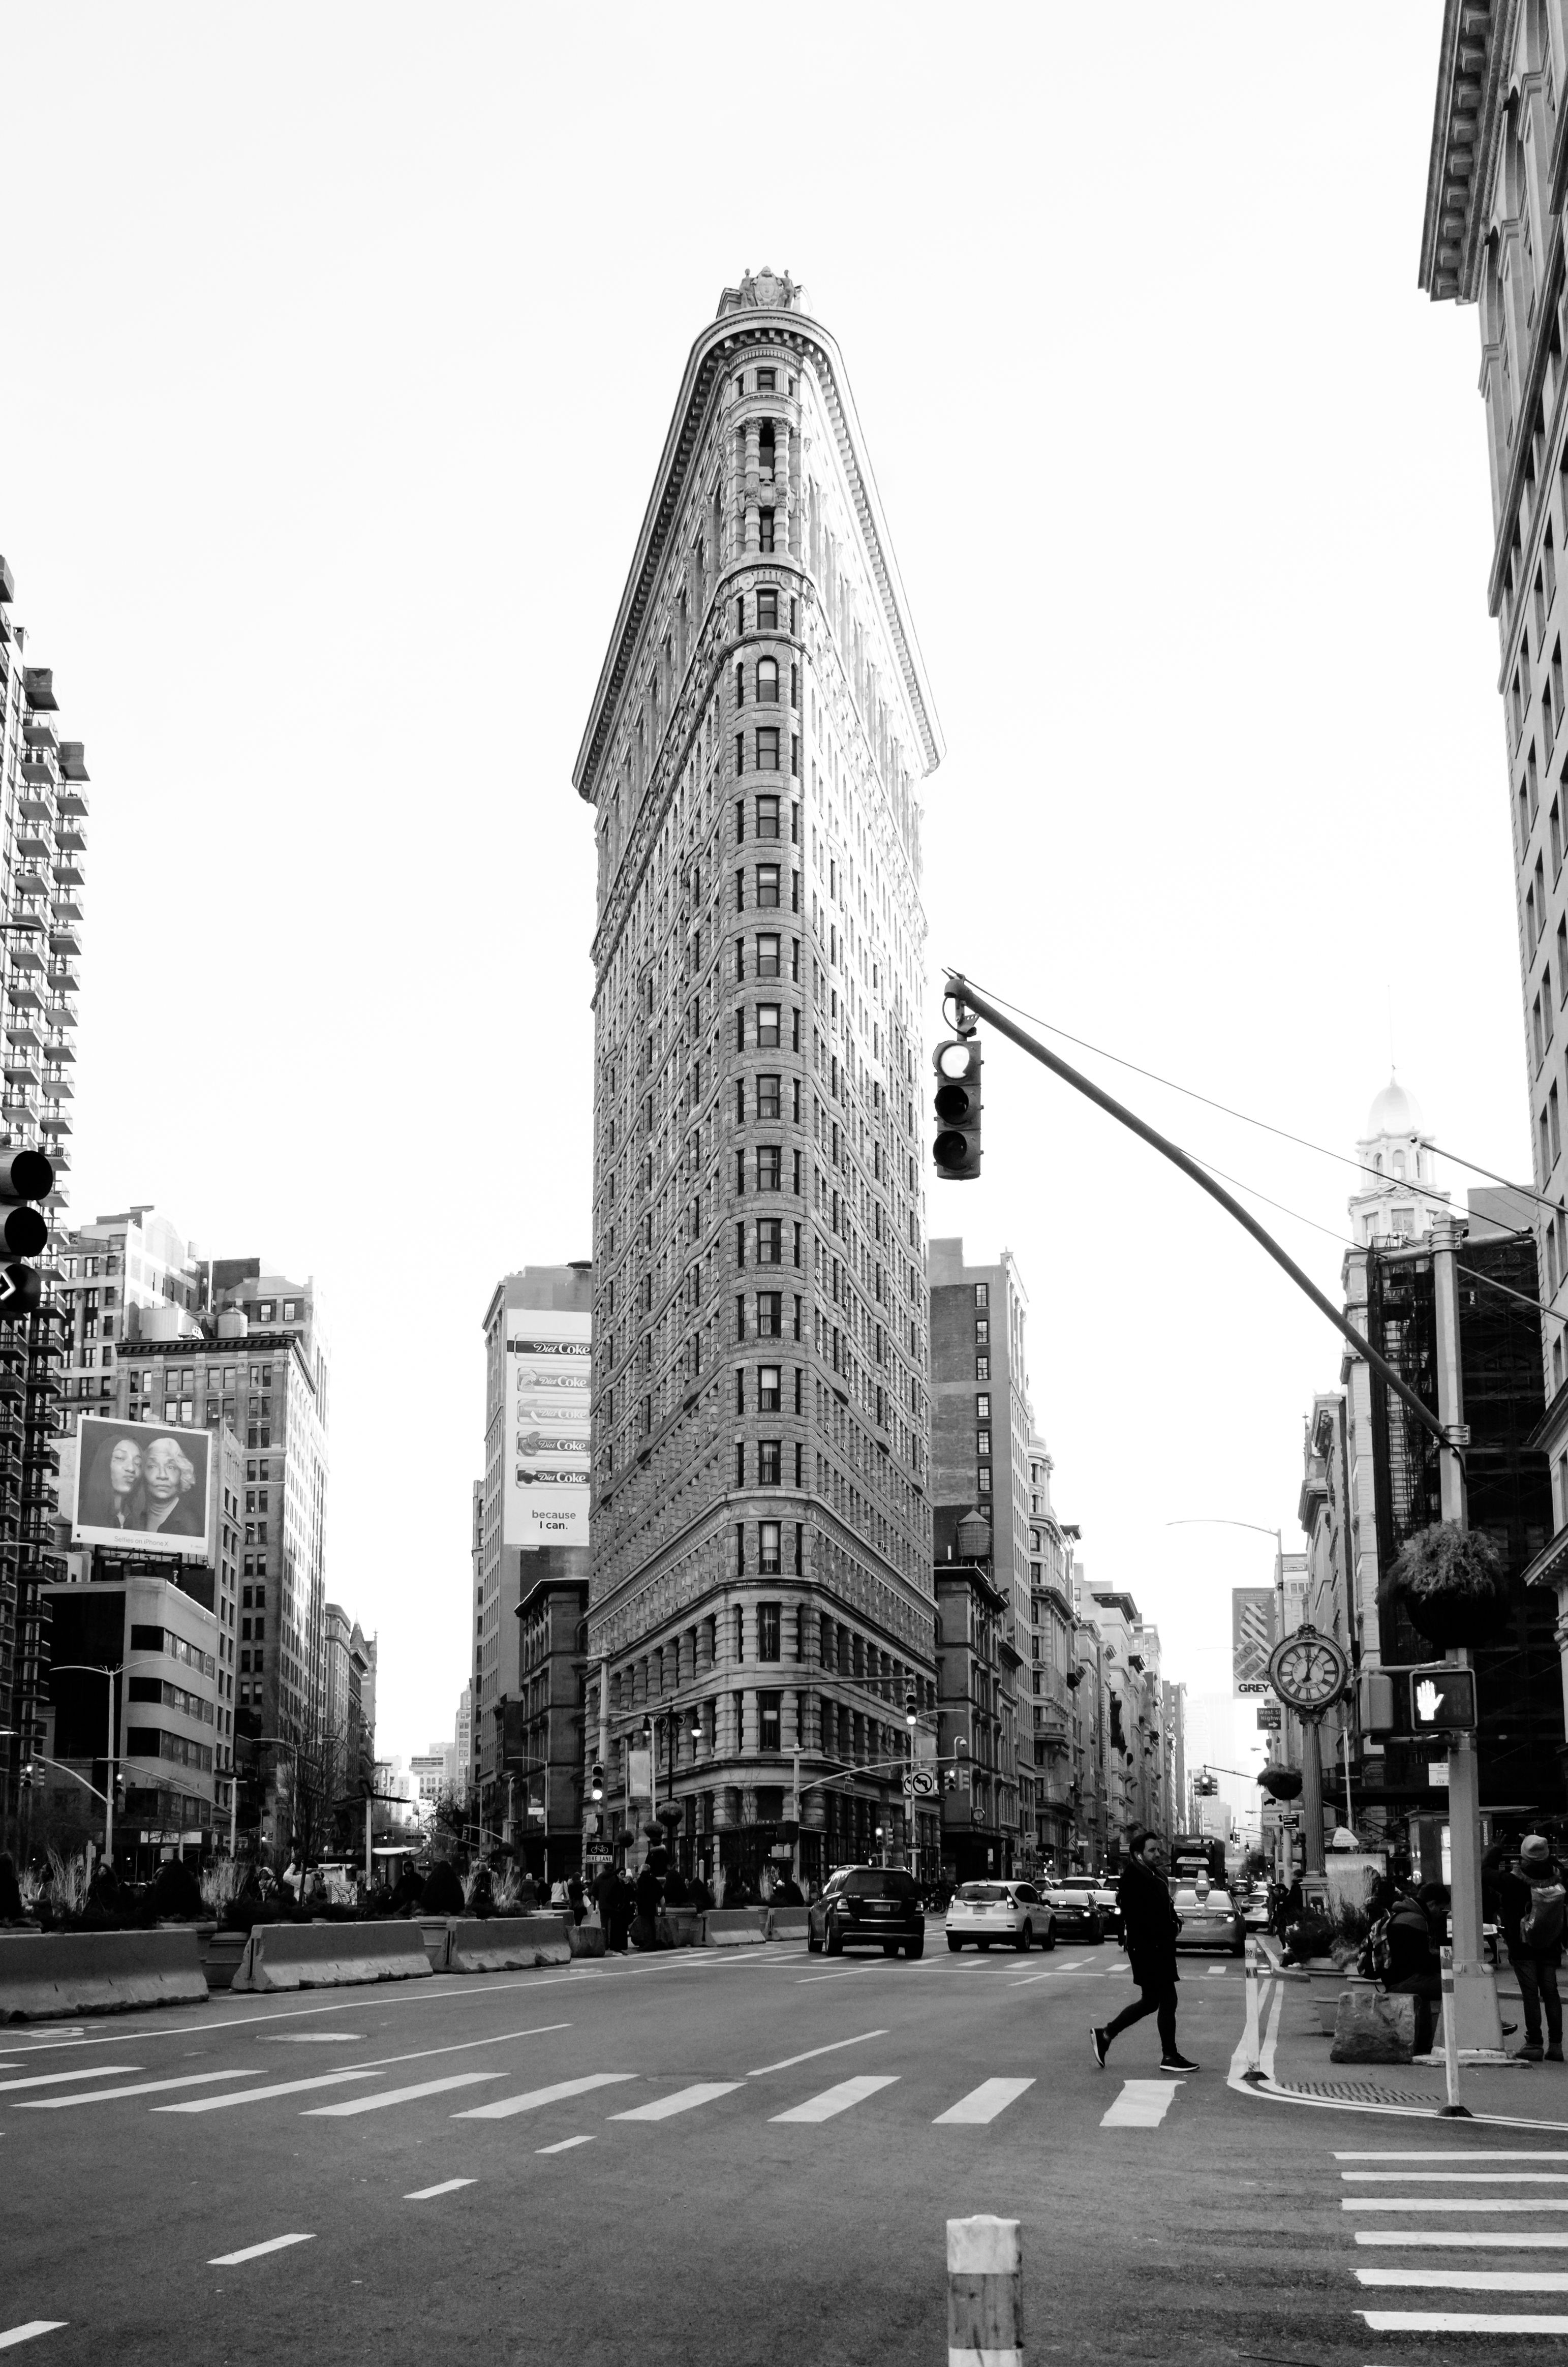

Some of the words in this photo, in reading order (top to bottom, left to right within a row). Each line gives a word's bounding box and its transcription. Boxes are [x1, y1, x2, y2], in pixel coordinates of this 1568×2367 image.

[533, 1342, 558, 1353] Diet
[559, 1343, 590, 1355] Coke
[539, 1376, 558, 1385] Diet
[558, 1376, 587, 1388] Coke
[539, 1408, 558, 1417] Diet
[558, 1408, 587, 1419] Coke
[557, 1440, 586, 1451] Coke
[538, 1472, 555, 1481] Diet
[557, 1472, 586, 1483] Coke
[532, 1510, 576, 1519] because
[540, 1521, 542, 1529] I
[1238, 1683, 1270, 1693] GREY
